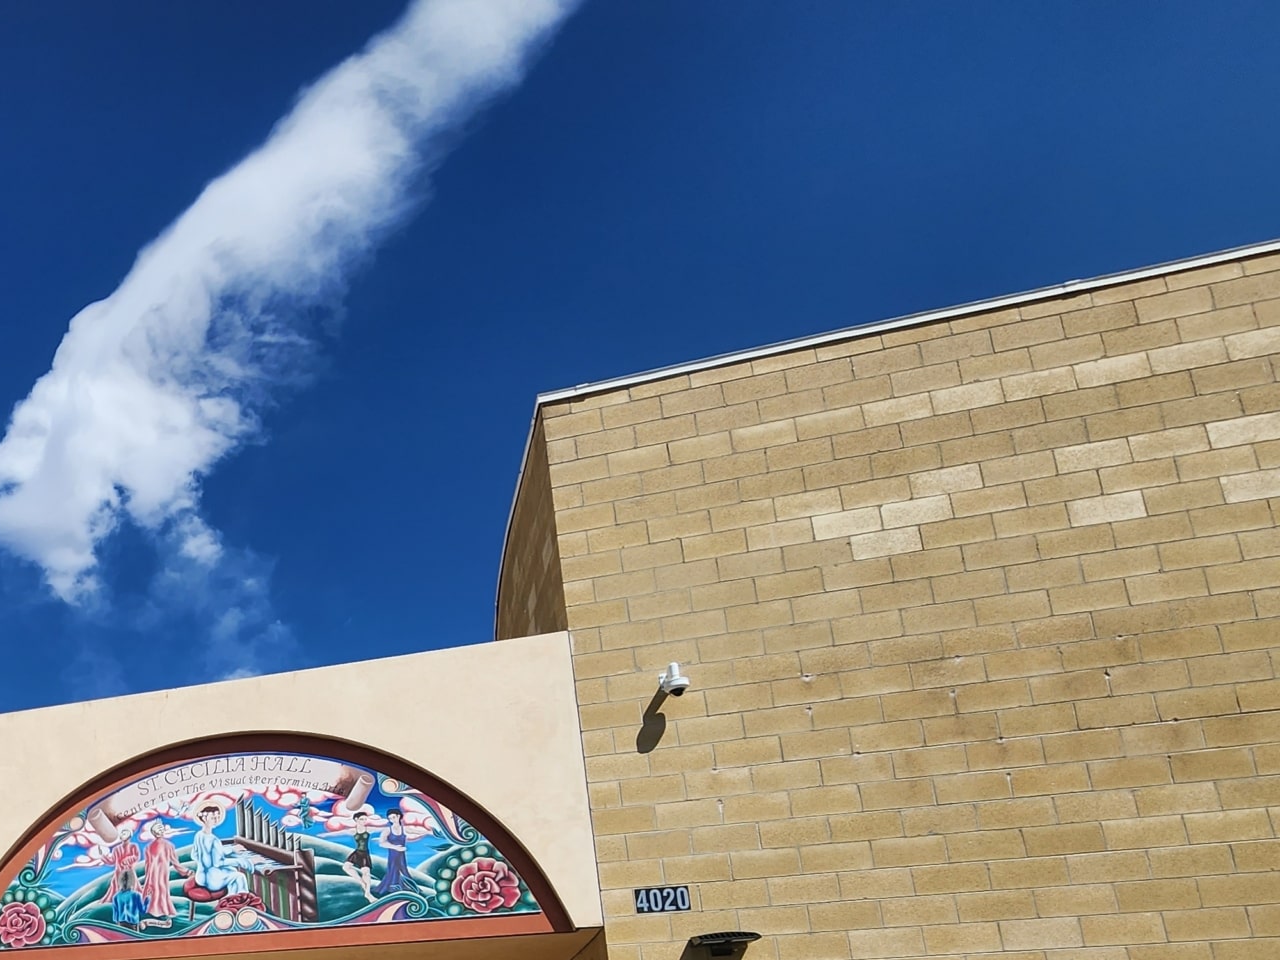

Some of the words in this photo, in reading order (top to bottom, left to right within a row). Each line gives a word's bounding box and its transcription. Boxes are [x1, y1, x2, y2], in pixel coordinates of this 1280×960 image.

[164, 757, 246, 785] CECILIA
[250, 756, 312, 774] HALL
[183, 782, 206, 795] The
[209, 776, 246, 790] Visual
[636, 887, 690, 912] 4020
